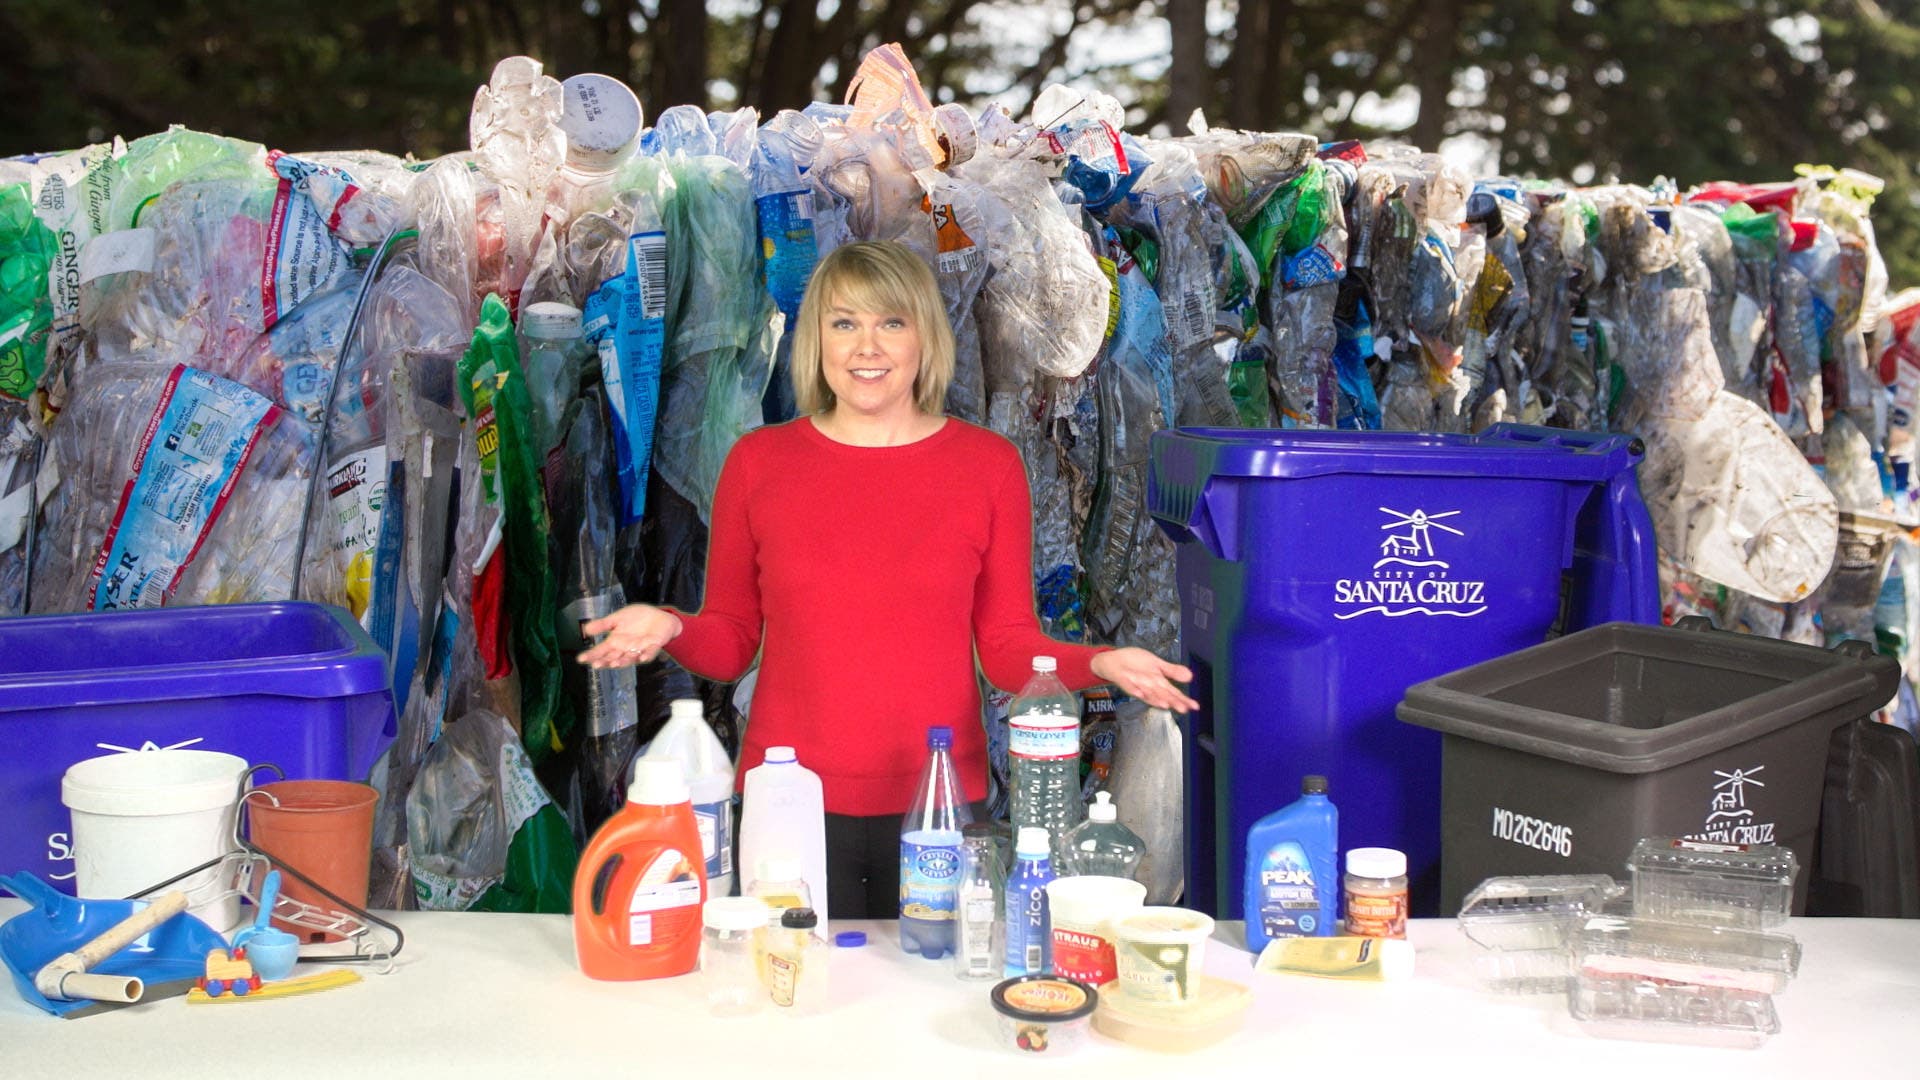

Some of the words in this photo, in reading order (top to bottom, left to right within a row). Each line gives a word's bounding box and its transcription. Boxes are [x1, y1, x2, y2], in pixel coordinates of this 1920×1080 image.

[101, 174, 113, 200] from
[88, 190, 103, 234] Ginger
[291, 243, 304, 264] Source
[62, 231, 79, 311] GINGER
[1373, 571, 1414, 579] CITY
[1428, 571, 1447, 579] OF
[1335, 579, 1416, 603] SANTA
[1416, 579, 1485, 604] CRUZ
[1731, 823, 1775, 844] CRUZ
[48, 833, 76, 860] S
[1262, 870, 1316, 887] PEAK
[1025, 889, 1042, 926] zico
